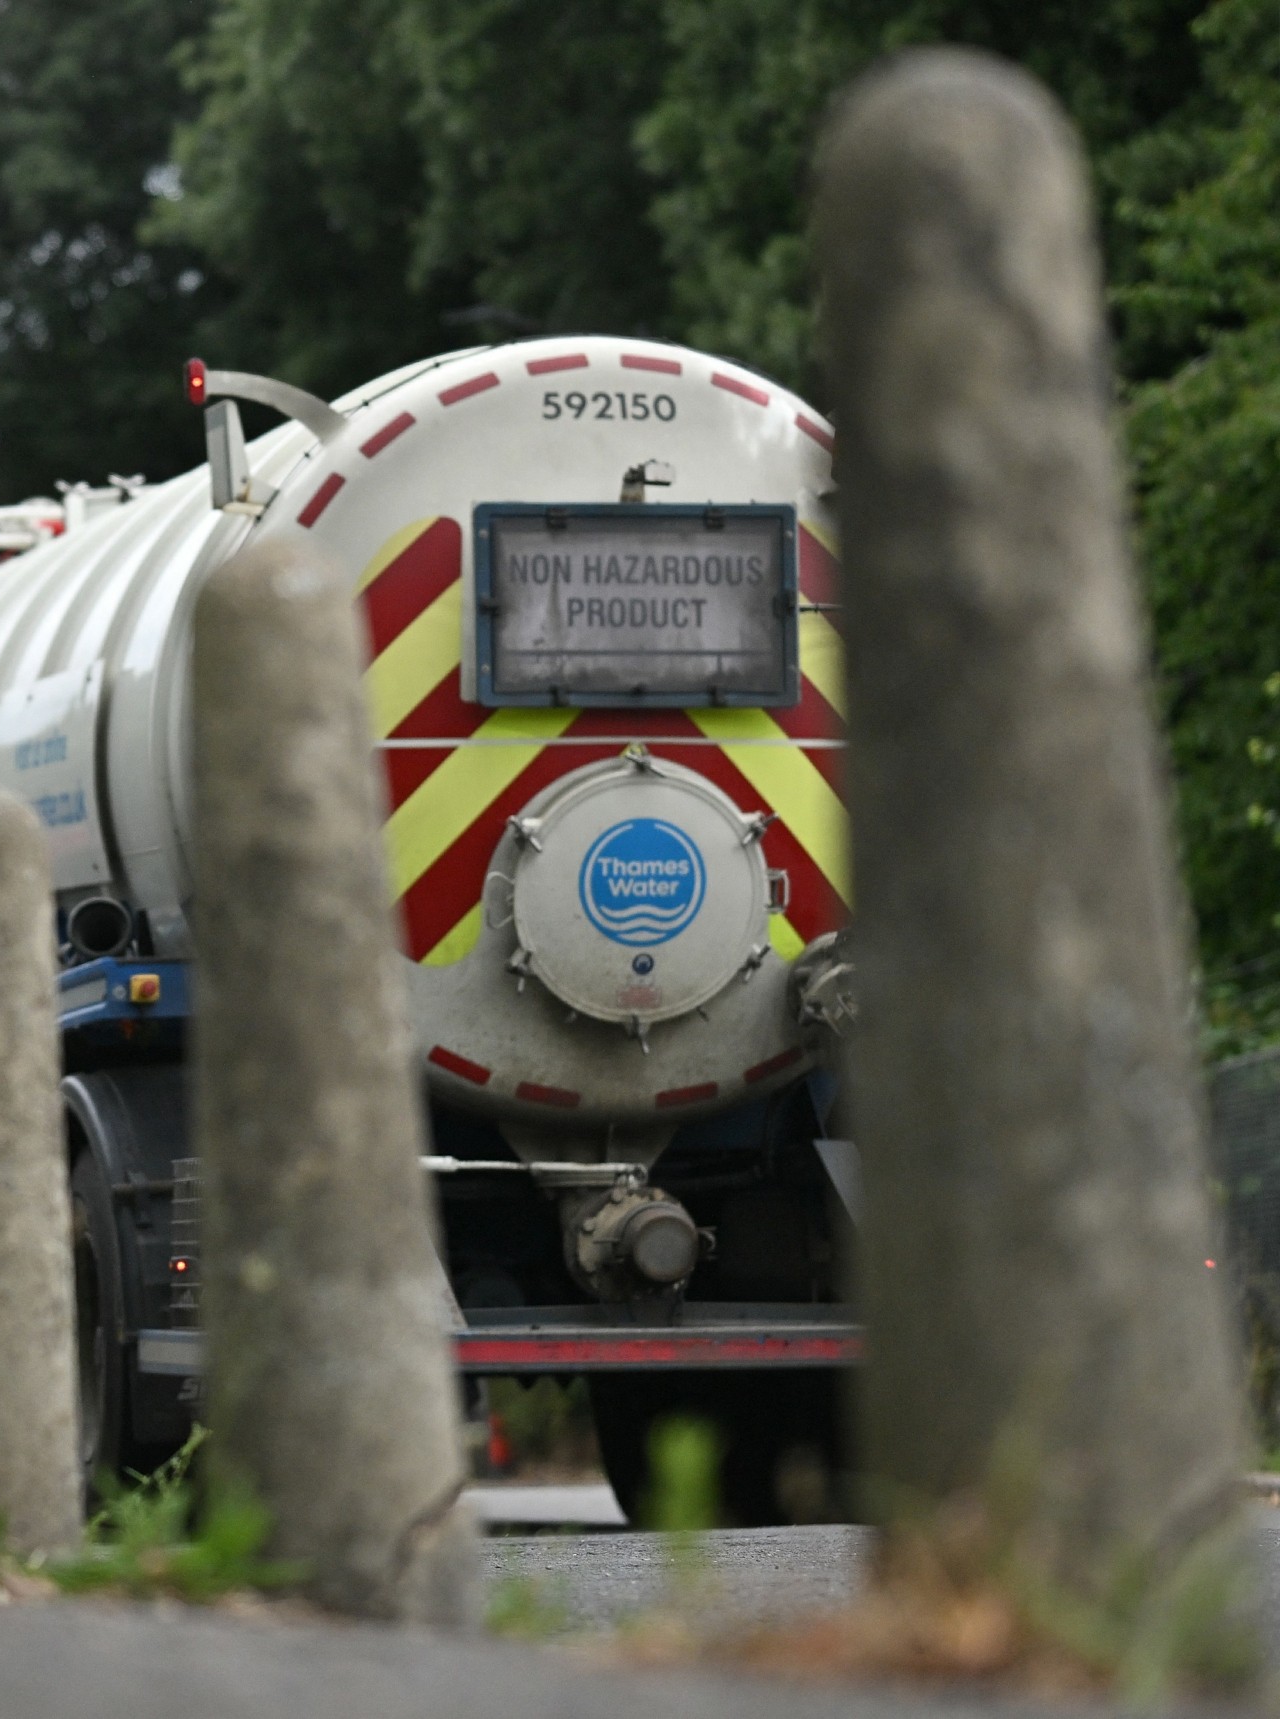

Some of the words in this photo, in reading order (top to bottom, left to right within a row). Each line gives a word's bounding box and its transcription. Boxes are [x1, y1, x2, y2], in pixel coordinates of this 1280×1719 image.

[543, 391, 677, 422] 592150
[511, 555, 571, 584] NON
[584, 555, 764, 586] HAZARDOUS
[568, 599, 708, 628] PRODUCT
[599, 857, 690, 876] Thames
[608, 878, 680, 897] Water
